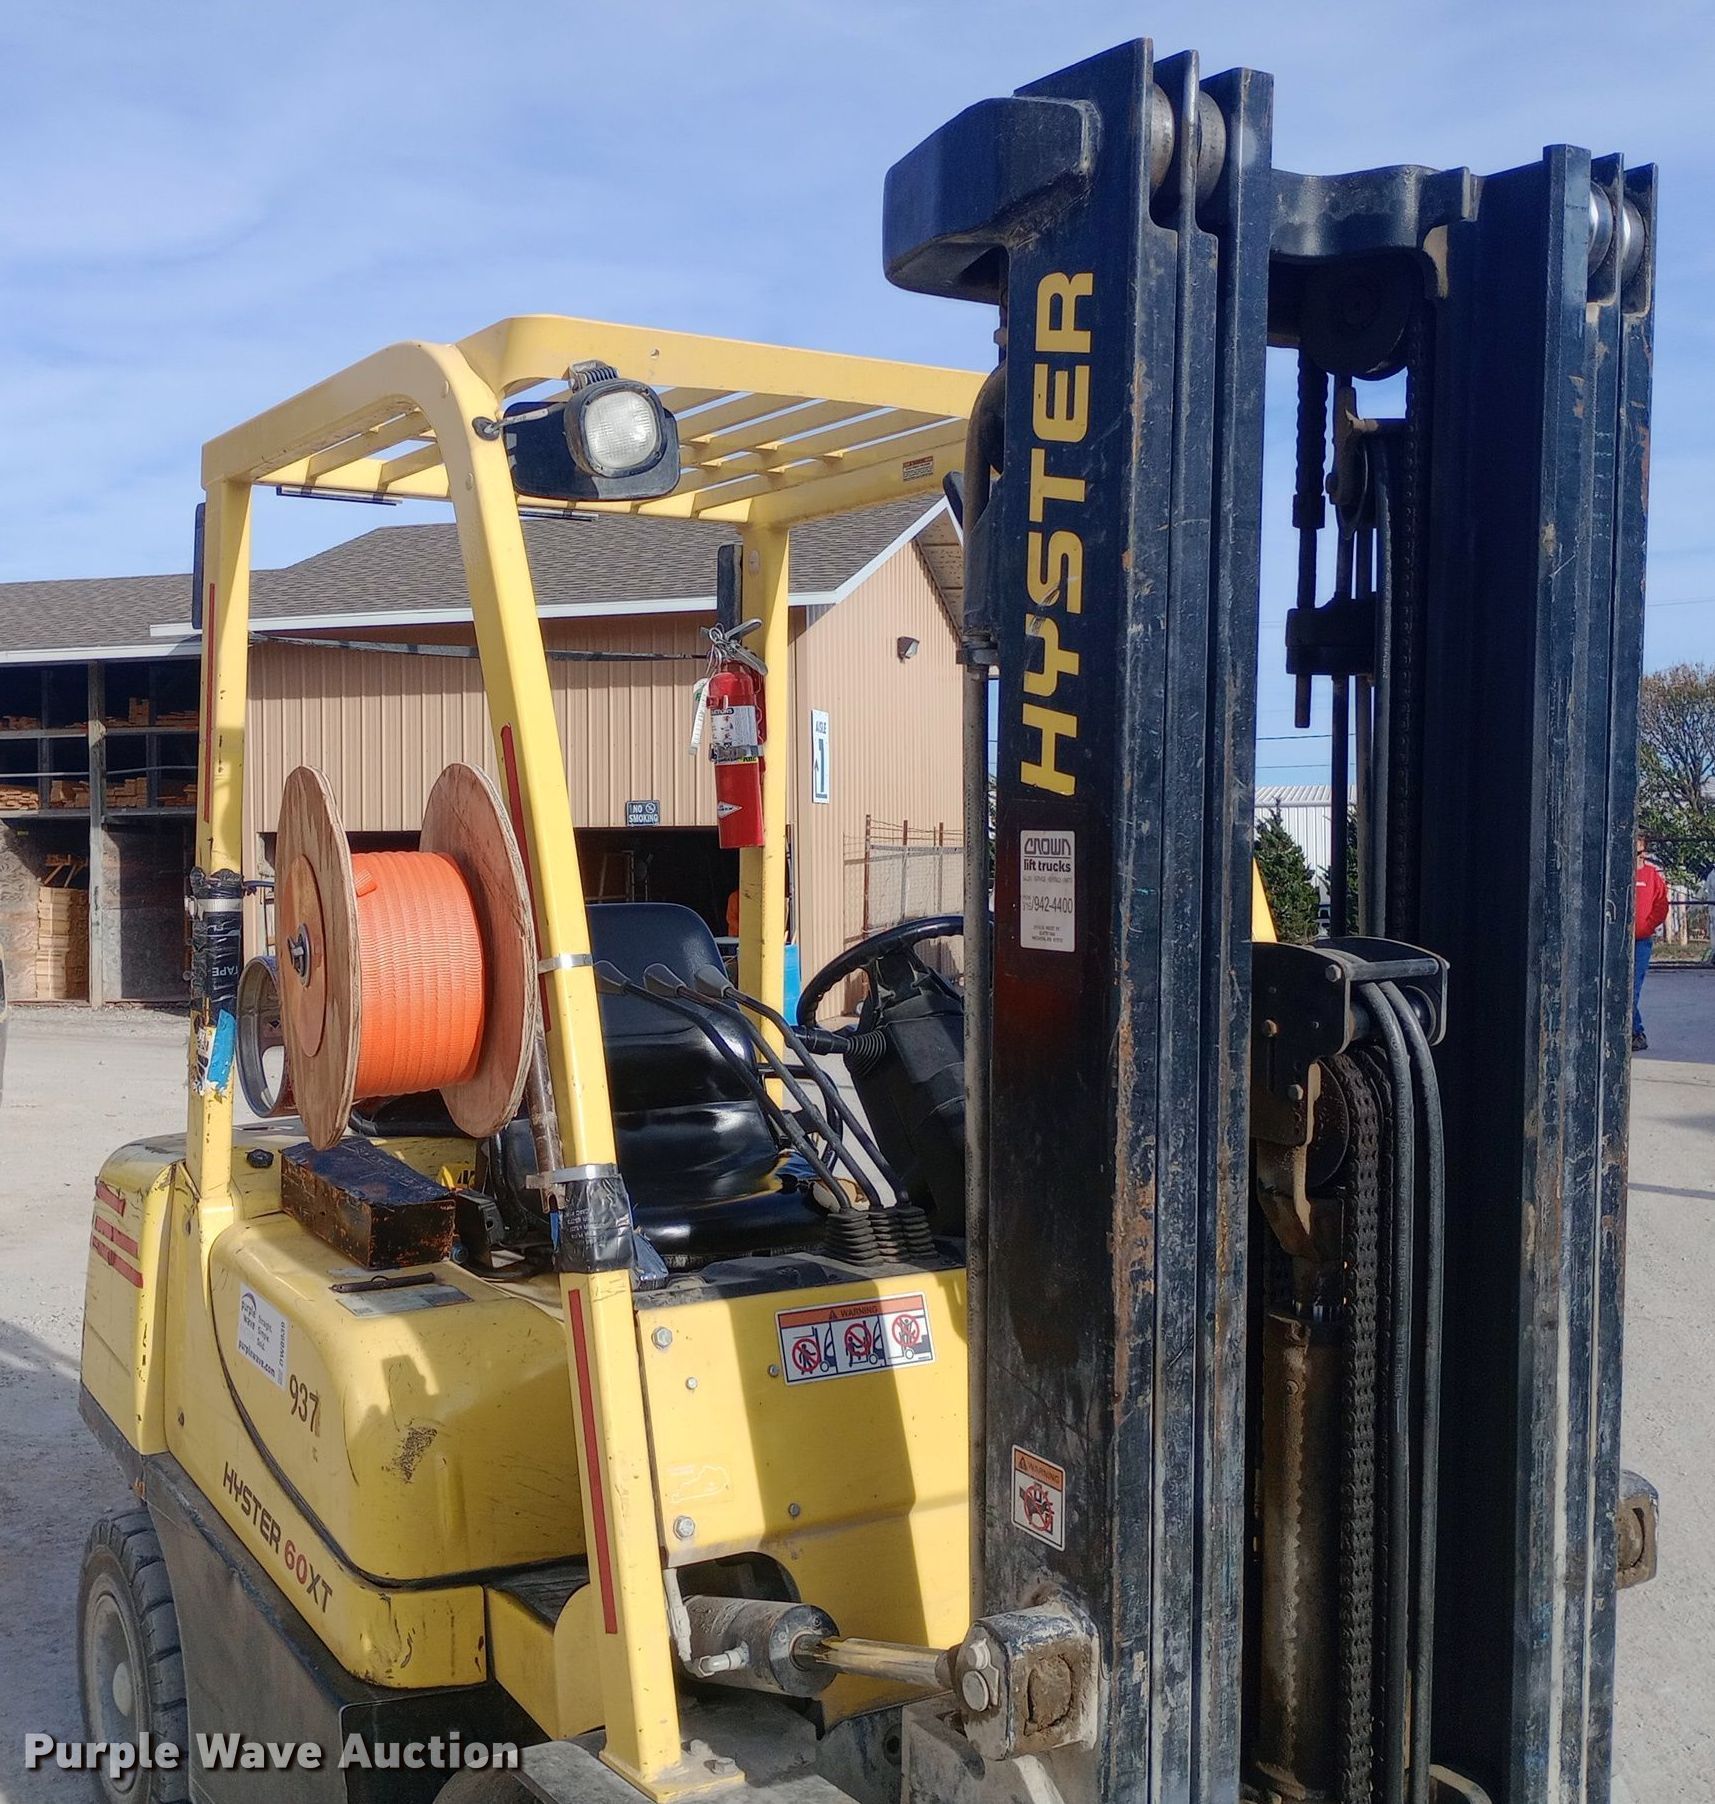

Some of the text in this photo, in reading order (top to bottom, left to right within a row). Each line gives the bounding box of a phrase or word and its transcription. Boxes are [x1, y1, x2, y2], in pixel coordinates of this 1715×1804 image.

[1021, 272, 1093, 796] HYSTER
[815, 720, 827, 735] AISLE
[818, 738, 825, 793] 1
[628, 814, 659, 824] SMOKING
[632, 805, 643, 814] NO
[1023, 858, 1072, 873] lift trucks
[840, 1306, 878, 1318] WARNING
[289, 1373, 319, 1432] 937
[1027, 1461, 1060, 1485] WARNING
[222, 1460, 282, 1554] HYSTER
